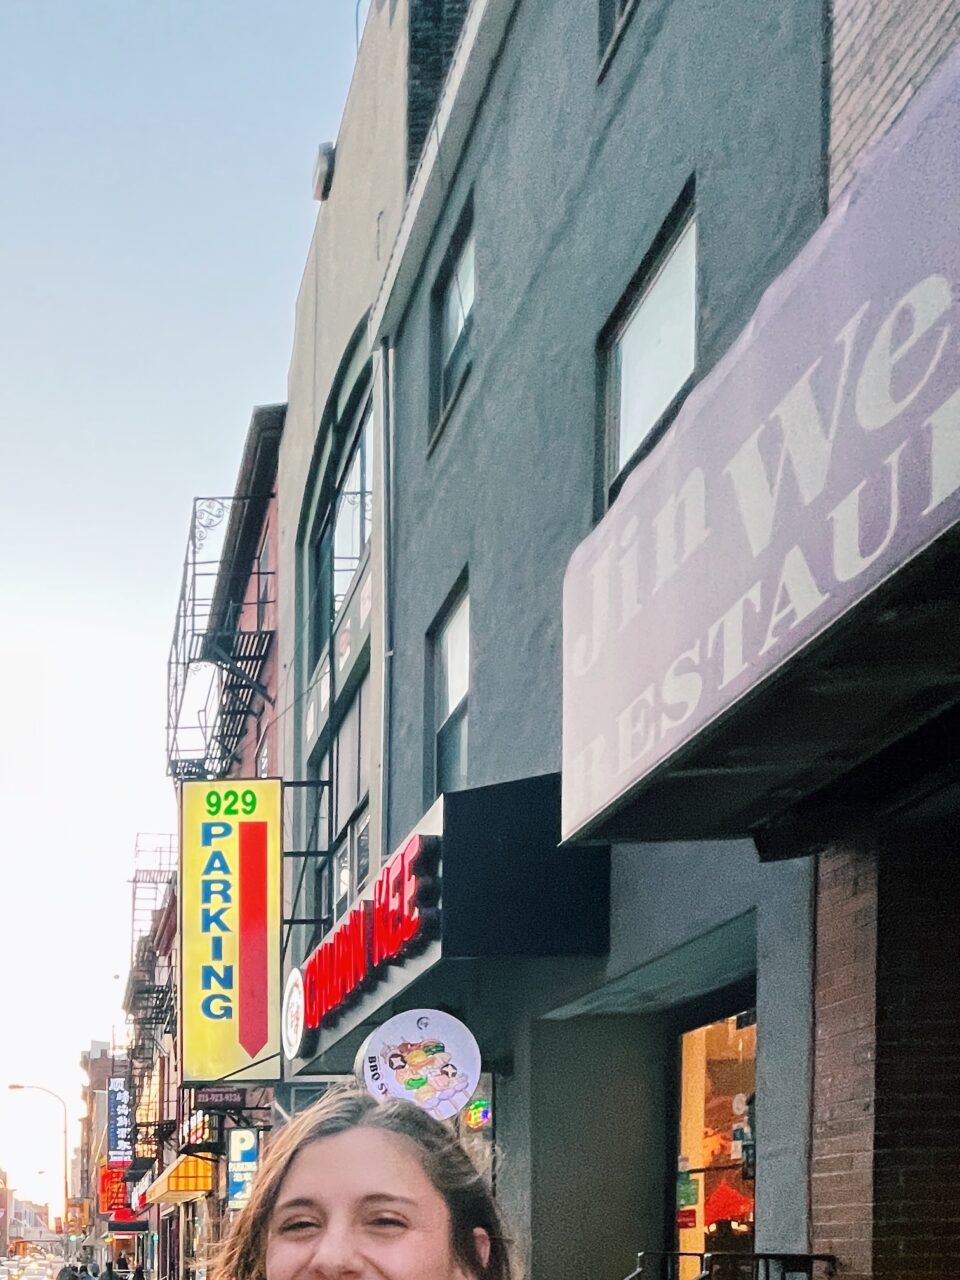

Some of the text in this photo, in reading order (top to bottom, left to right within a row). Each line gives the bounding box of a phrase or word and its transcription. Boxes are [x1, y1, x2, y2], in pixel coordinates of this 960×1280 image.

[572, 462, 711, 676] Jin
[205, 789, 257, 816] 929
[201, 821, 234, 1021] PARKING
[373, 834, 422, 968] KEE
[367, 1055, 381, 1081] BBQ
[230, 1130, 255, 1161] P
